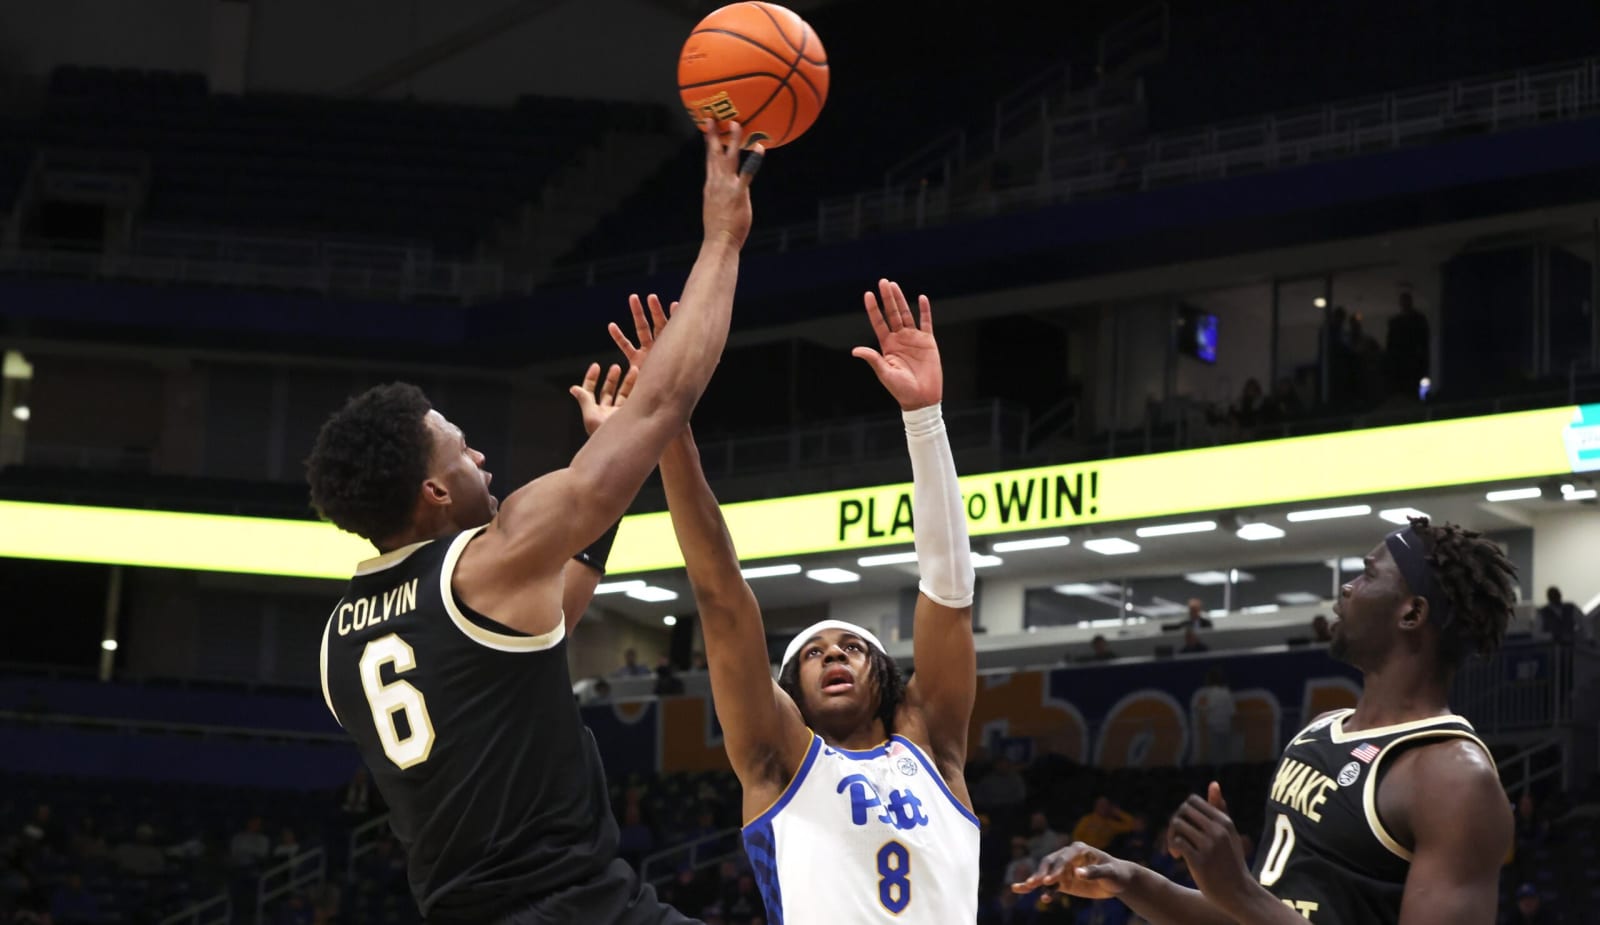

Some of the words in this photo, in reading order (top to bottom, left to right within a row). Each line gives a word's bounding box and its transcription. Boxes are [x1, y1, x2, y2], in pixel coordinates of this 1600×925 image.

[839, 493, 915, 541] PLA
[995, 472, 1098, 524] WIN!
[338, 578, 419, 636] COLVIN
[359, 632, 436, 770] 6
[1270, 757, 1339, 823] WAKE
[876, 838, 911, 917] 8
[1260, 814, 1296, 886] 0
